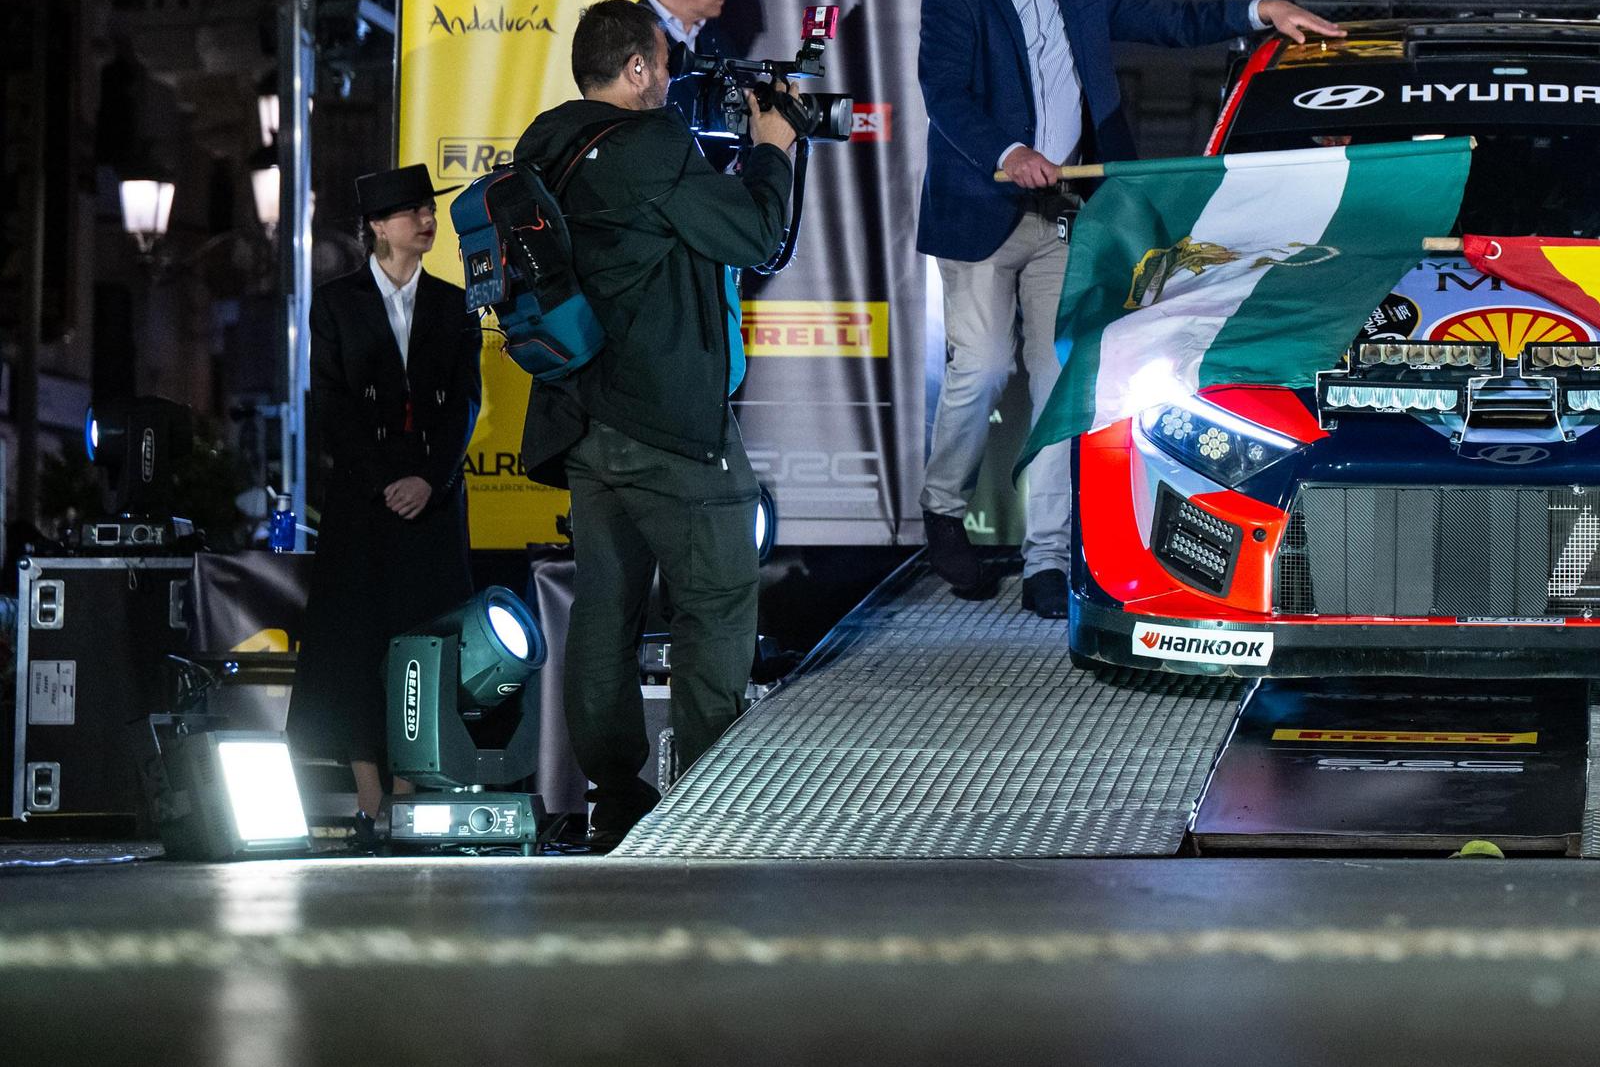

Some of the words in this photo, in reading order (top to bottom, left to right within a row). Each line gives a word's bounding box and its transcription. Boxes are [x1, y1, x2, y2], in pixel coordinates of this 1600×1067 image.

[427, 4, 559, 35] Andalucía
[408, 669, 418, 705] BEAM
[407, 706, 416, 733] 230
